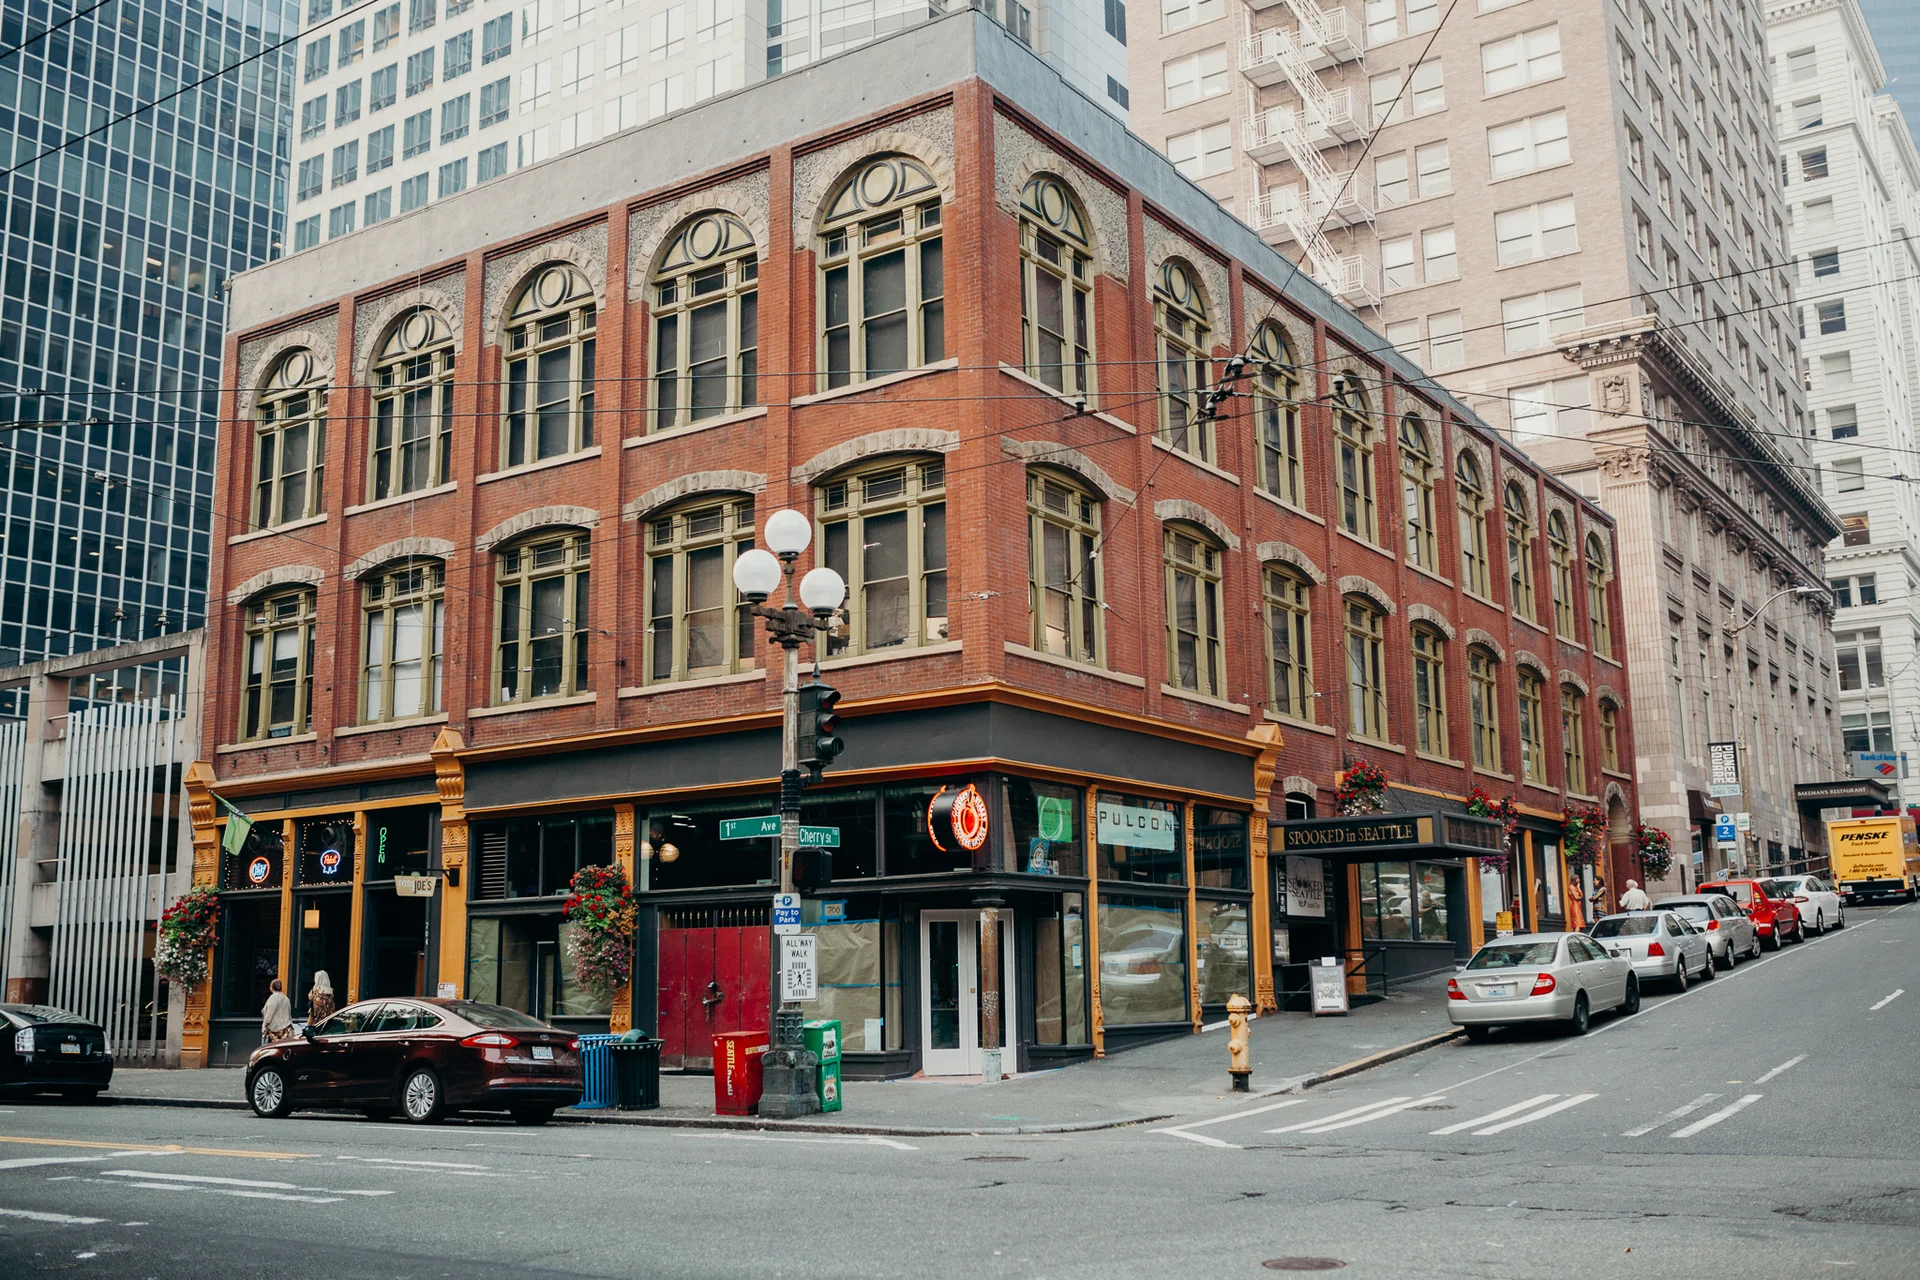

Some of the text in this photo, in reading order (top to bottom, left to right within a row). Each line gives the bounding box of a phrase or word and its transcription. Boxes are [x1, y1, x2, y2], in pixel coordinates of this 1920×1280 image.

[1711, 745, 1725, 784] SQUARE
[1722, 745, 1736, 783] PIONEER
[1797, 787, 1867, 797] BAKEMAN'S RESTAURANT
[725, 821, 777, 836] 1st Ave
[1099, 810, 1173, 832] PULCON
[799, 828, 825, 846] Cherry
[1288, 824, 1413, 846] SPOOKED in SEATTLE
[1722, 826, 1730, 835] 2
[1840, 831, 1889, 841] PENSKE
[378, 826, 387, 863] OPEN
[414, 878, 433, 894] JOE'S
[775, 909, 790, 917] Pay
[827, 906, 841, 914] 700
[799, 939, 813, 947] WAY
[726, 1039, 735, 1070] SEATTLE
